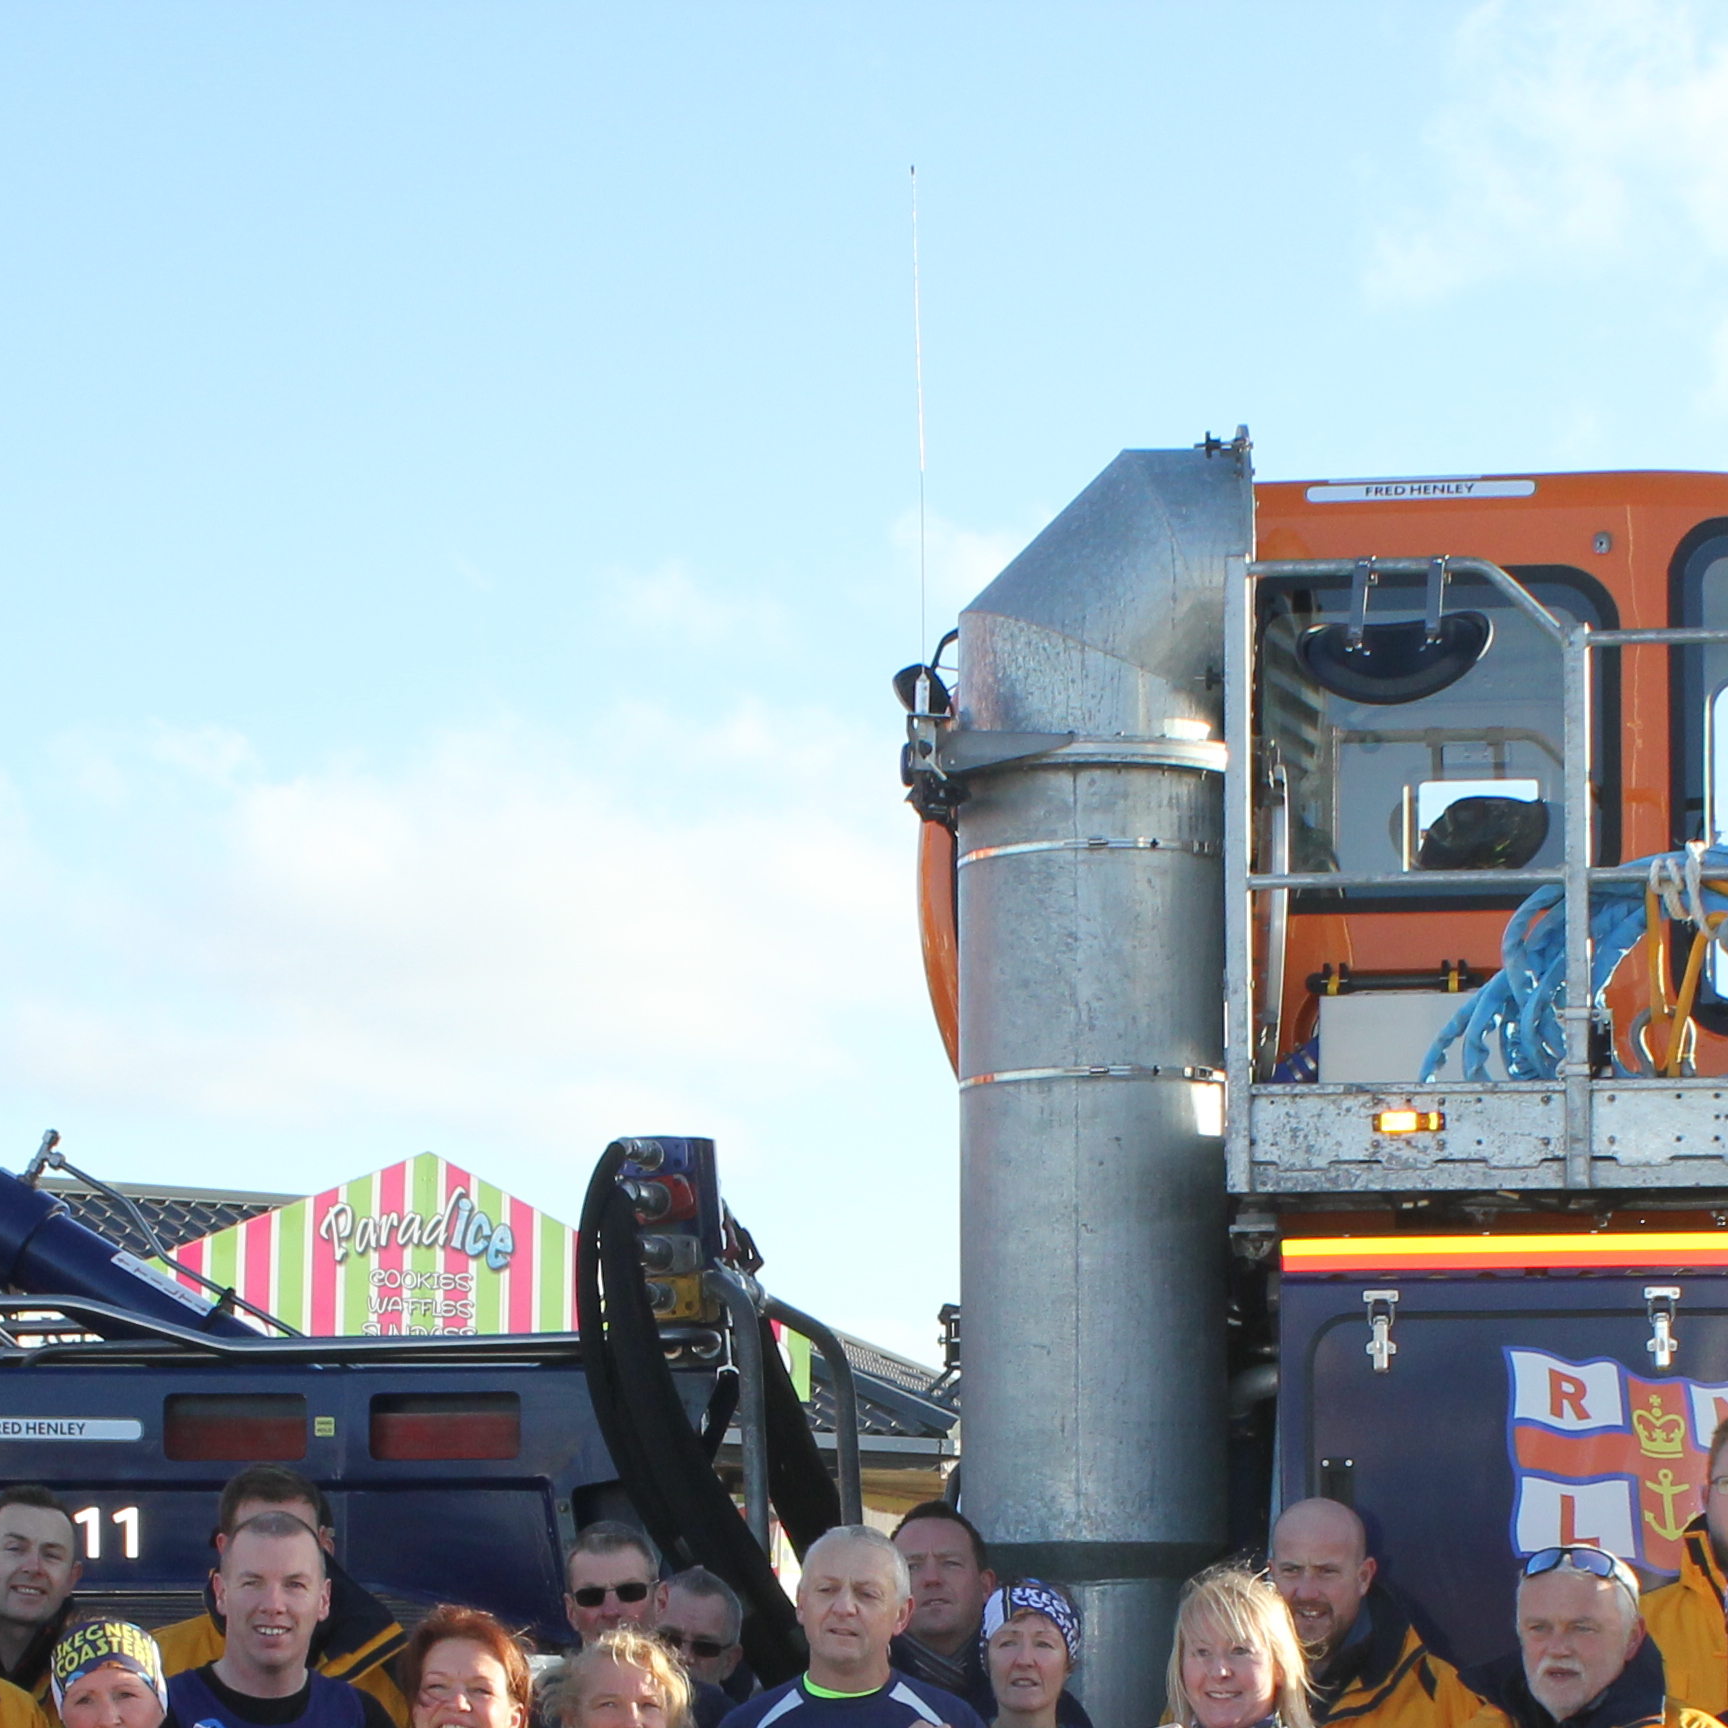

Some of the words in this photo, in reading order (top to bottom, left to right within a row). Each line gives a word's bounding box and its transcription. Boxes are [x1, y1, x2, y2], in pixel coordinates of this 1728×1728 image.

[1365, 485, 1406, 497] FRED
[1410, 483, 1474, 495] HENLEY
[370, 1269, 473, 1291] COOKIES
[368, 1296, 474, 1318] WAFFLES
[1549, 1368, 1591, 1420] R
[25, 1422, 85, 1436] HENLEY
[56, 1636, 154, 1678] COASTERS
